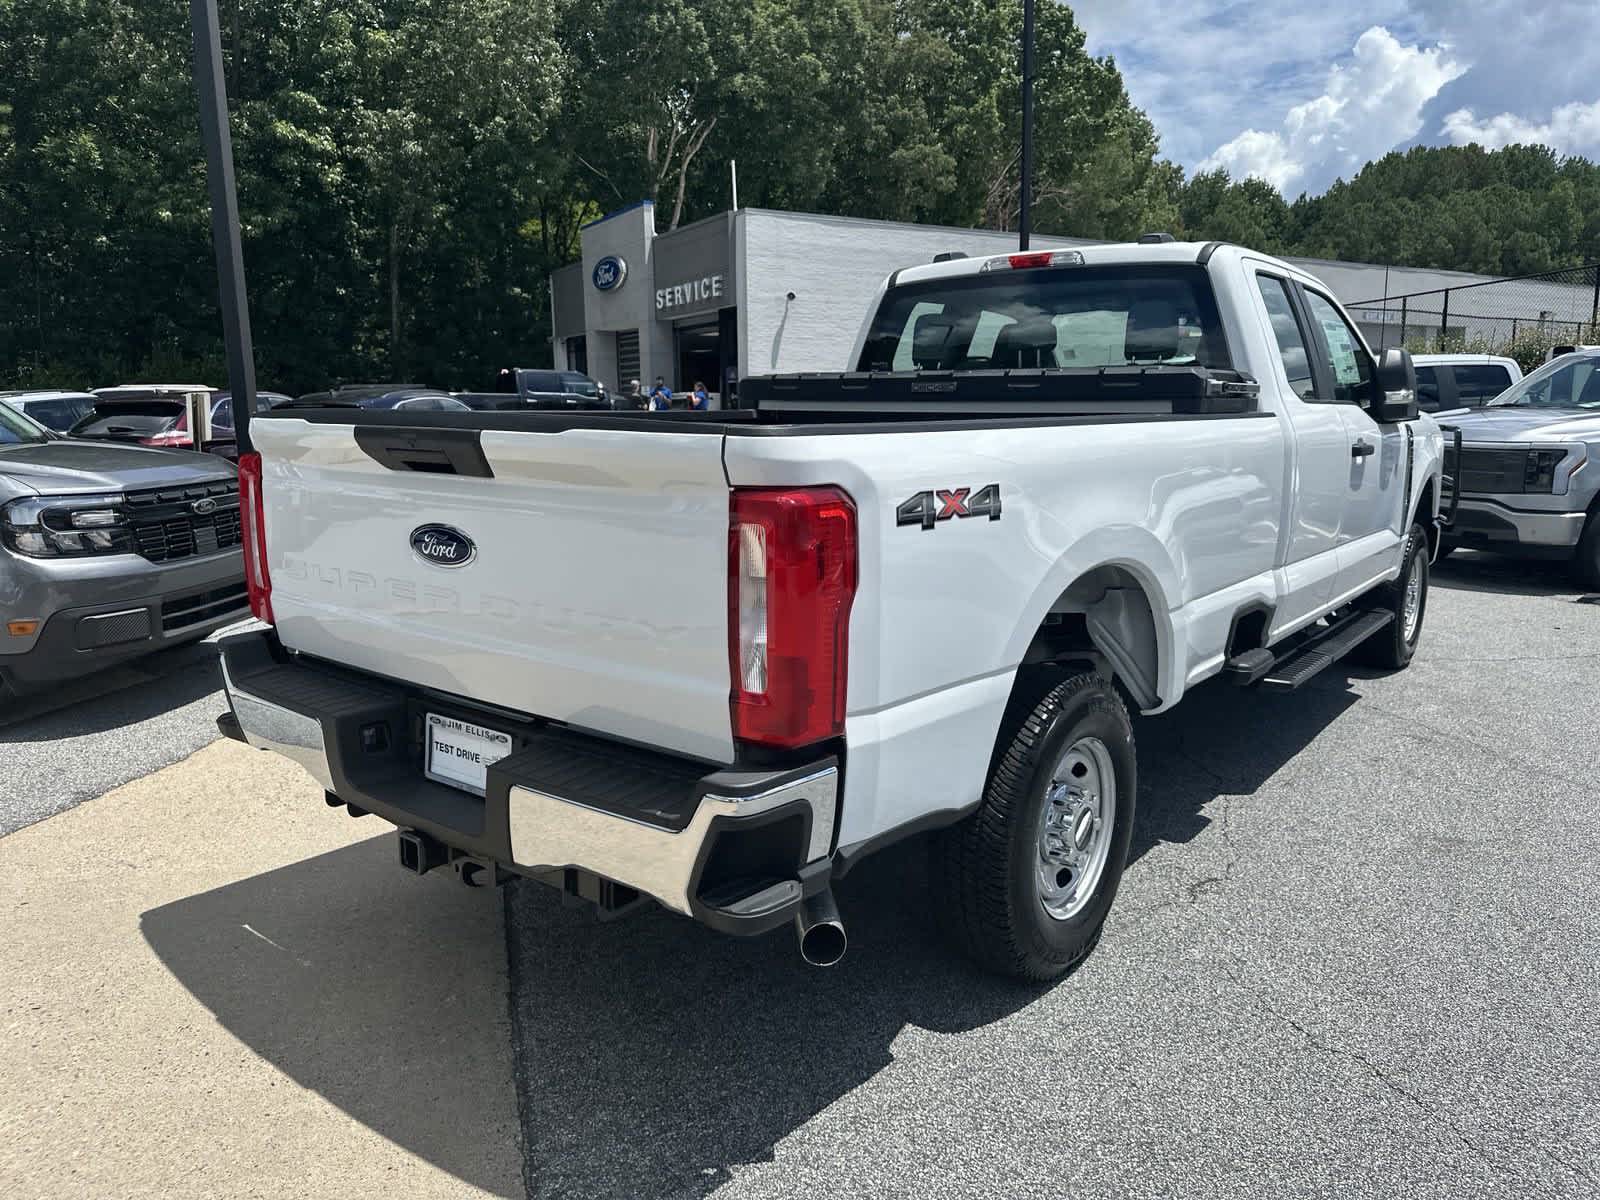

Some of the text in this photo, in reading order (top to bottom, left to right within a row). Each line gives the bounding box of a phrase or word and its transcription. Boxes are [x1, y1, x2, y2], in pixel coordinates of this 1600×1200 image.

[656, 276, 723, 309] SERVICE
[421, 531, 458, 559] Ford
[447, 720, 463, 731] JIM
[465, 725, 491, 740] ELLIS
[434, 741, 455, 756] TEST
[456, 747, 481, 764] DRIVE
